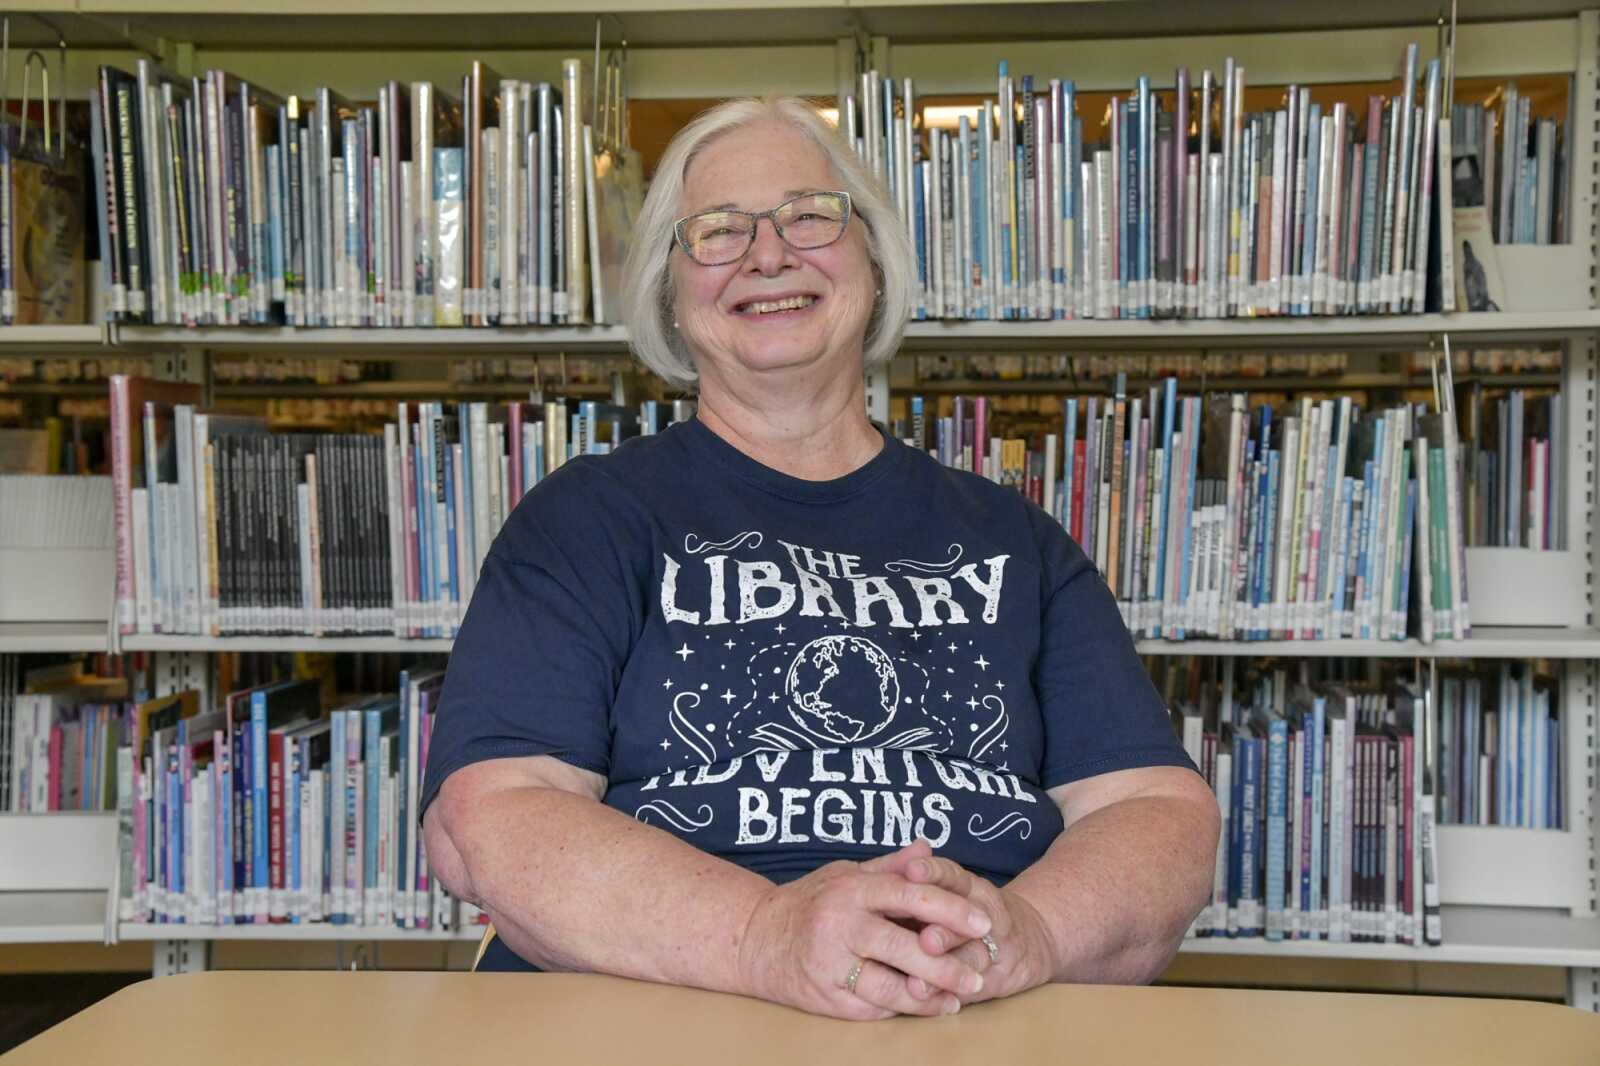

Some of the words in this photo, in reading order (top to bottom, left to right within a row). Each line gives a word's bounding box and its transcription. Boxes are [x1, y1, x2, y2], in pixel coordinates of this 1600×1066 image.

[777, 539, 867, 578] THE
[660, 552, 1011, 628] LIBRARY
[735, 787, 954, 848] BEGINS
[1242, 853, 1254, 898] CONSTITUT
